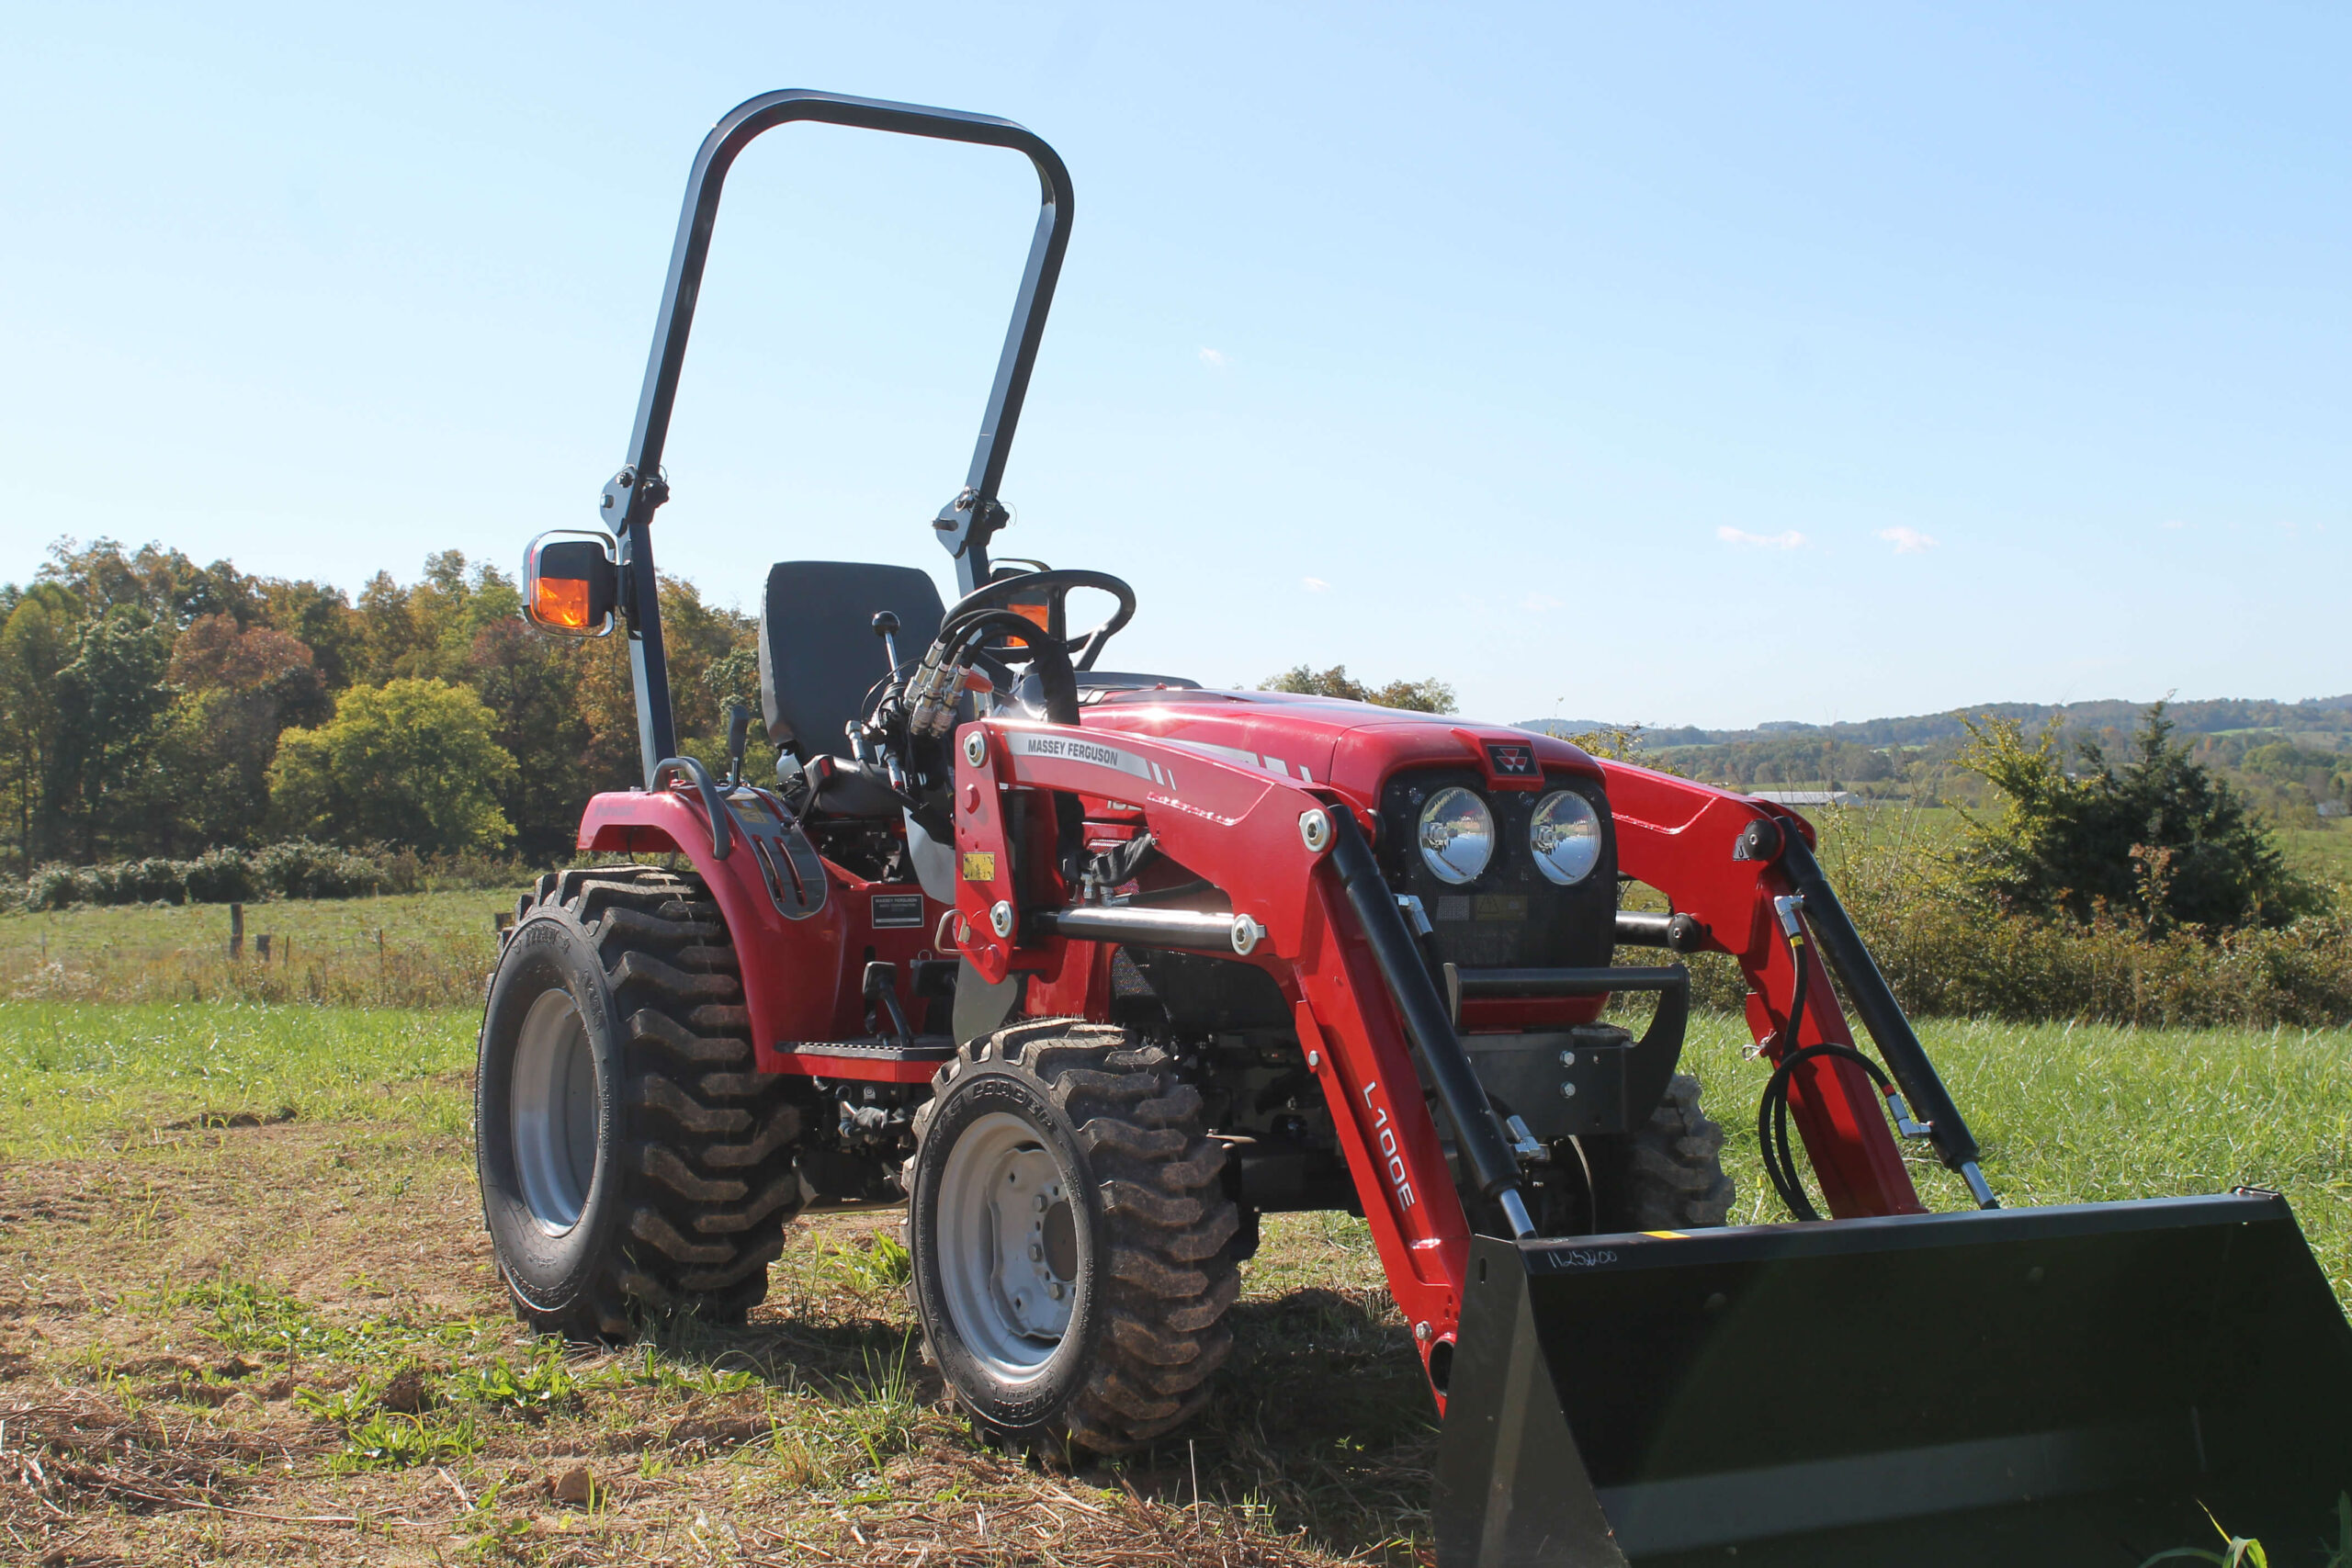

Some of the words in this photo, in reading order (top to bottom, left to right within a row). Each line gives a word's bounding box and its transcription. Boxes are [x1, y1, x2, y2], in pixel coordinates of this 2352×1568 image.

[1027, 739, 1067, 755] MASSEY
[1068, 742, 1118, 767] FERGUSON
[1363, 1081, 1415, 1212] L100E
